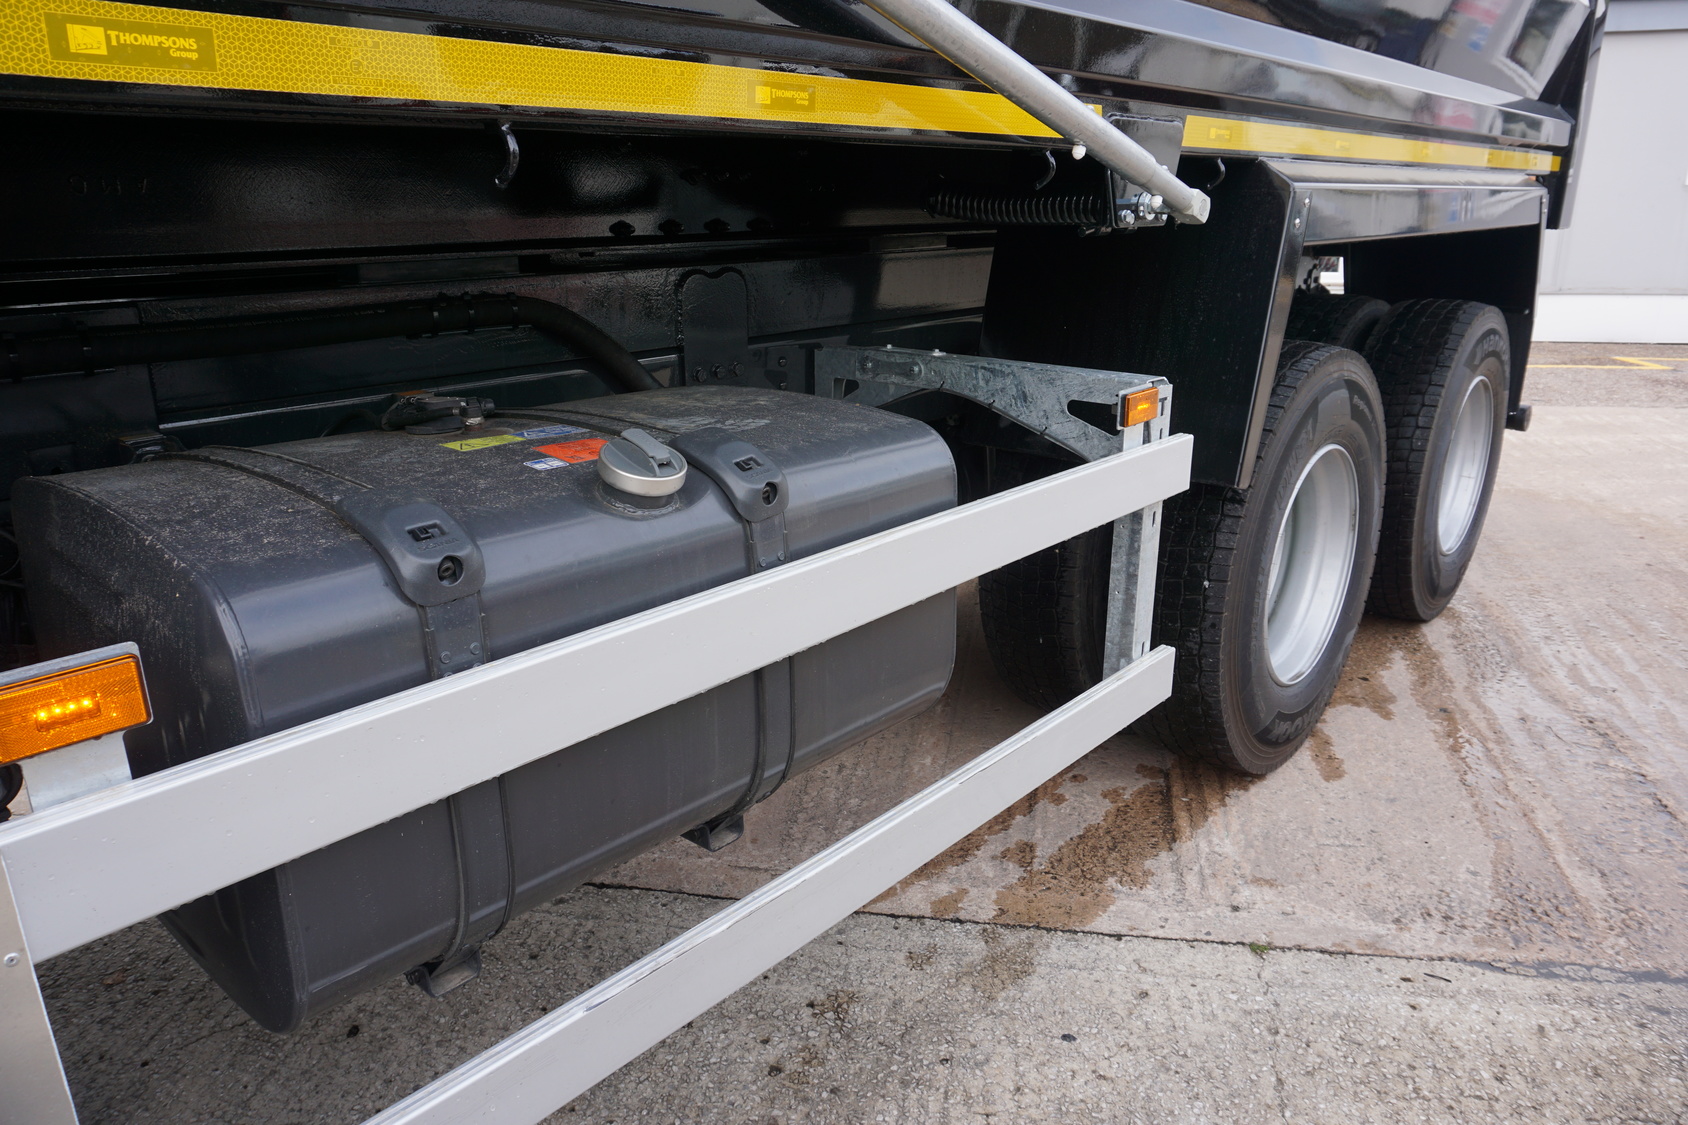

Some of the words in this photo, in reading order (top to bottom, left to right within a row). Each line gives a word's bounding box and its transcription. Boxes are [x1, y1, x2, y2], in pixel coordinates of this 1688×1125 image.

[106, 29, 198, 50] THOMPSONS
[169, 48, 199, 60] Group
[771, 88, 809, 99] THOMPSONS
